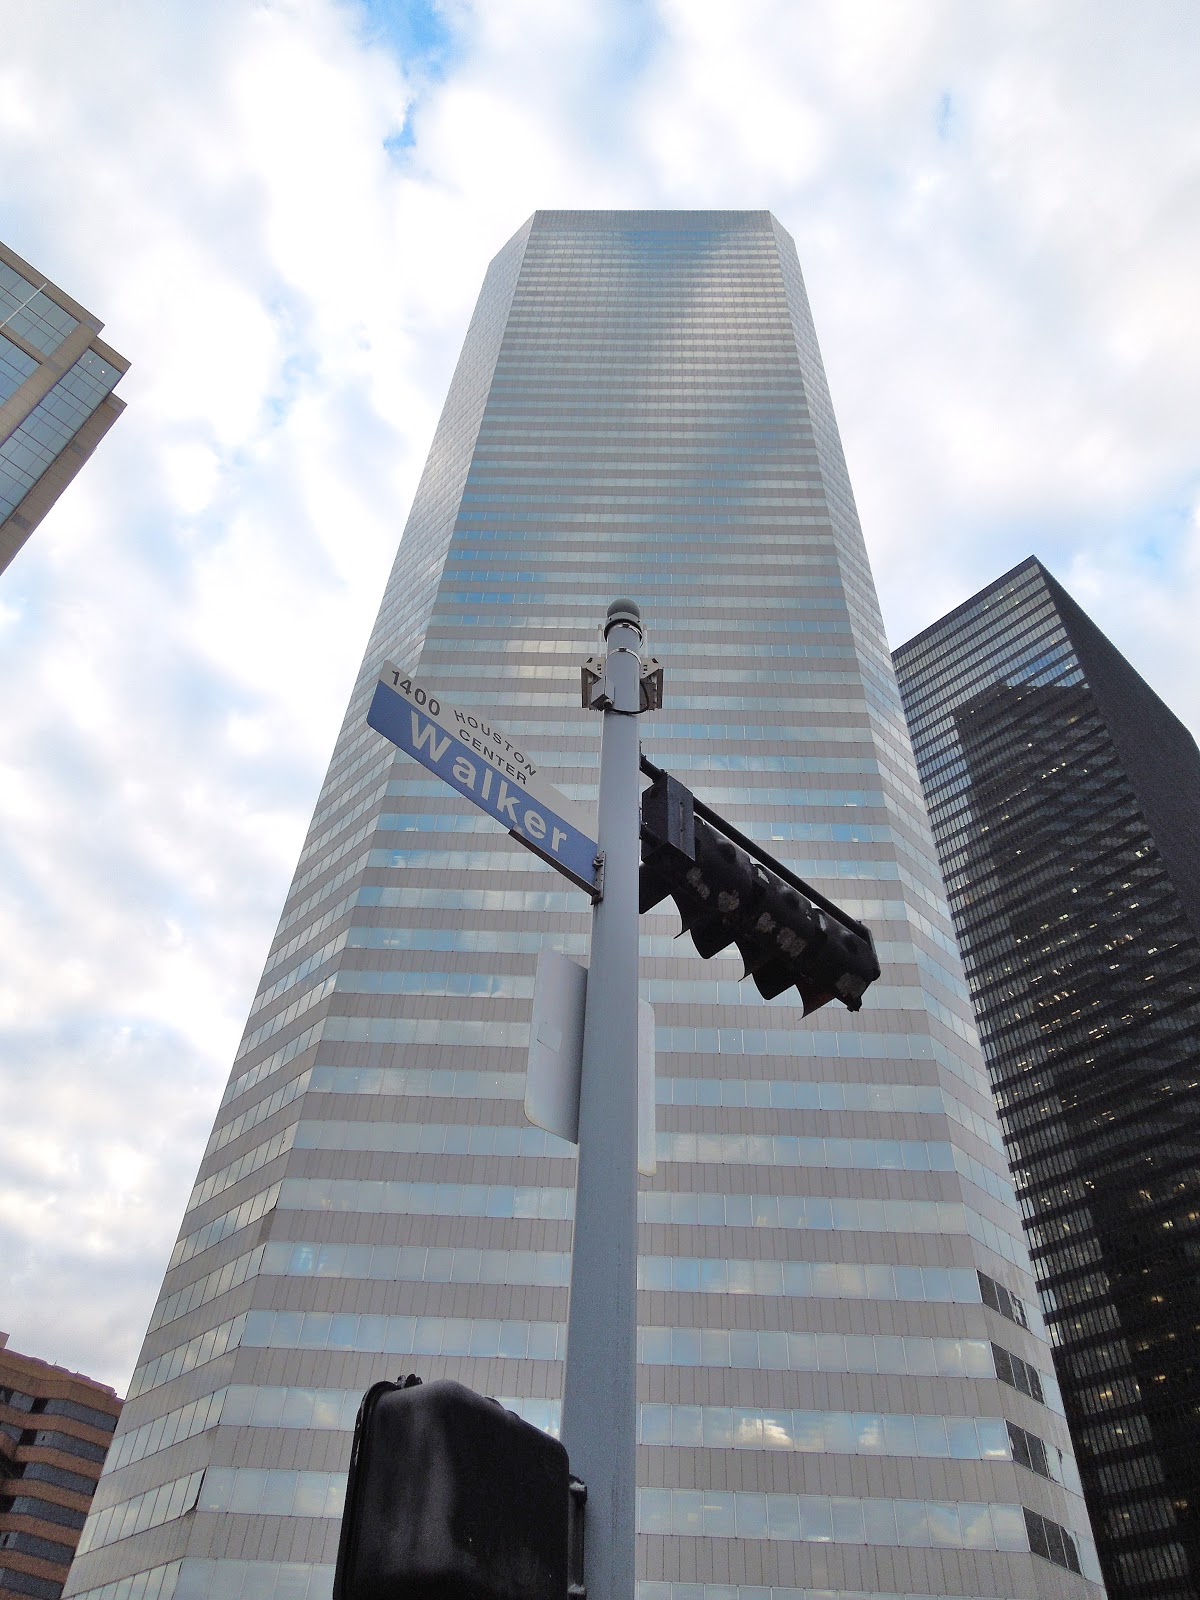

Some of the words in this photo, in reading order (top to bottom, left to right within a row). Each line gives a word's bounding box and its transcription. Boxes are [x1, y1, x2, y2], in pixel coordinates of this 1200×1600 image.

[392, 670, 441, 717] 1400
[453, 709, 537, 776] HOUSTON
[459, 728, 527, 785] CENTER
[410, 710, 568, 852] Walker
